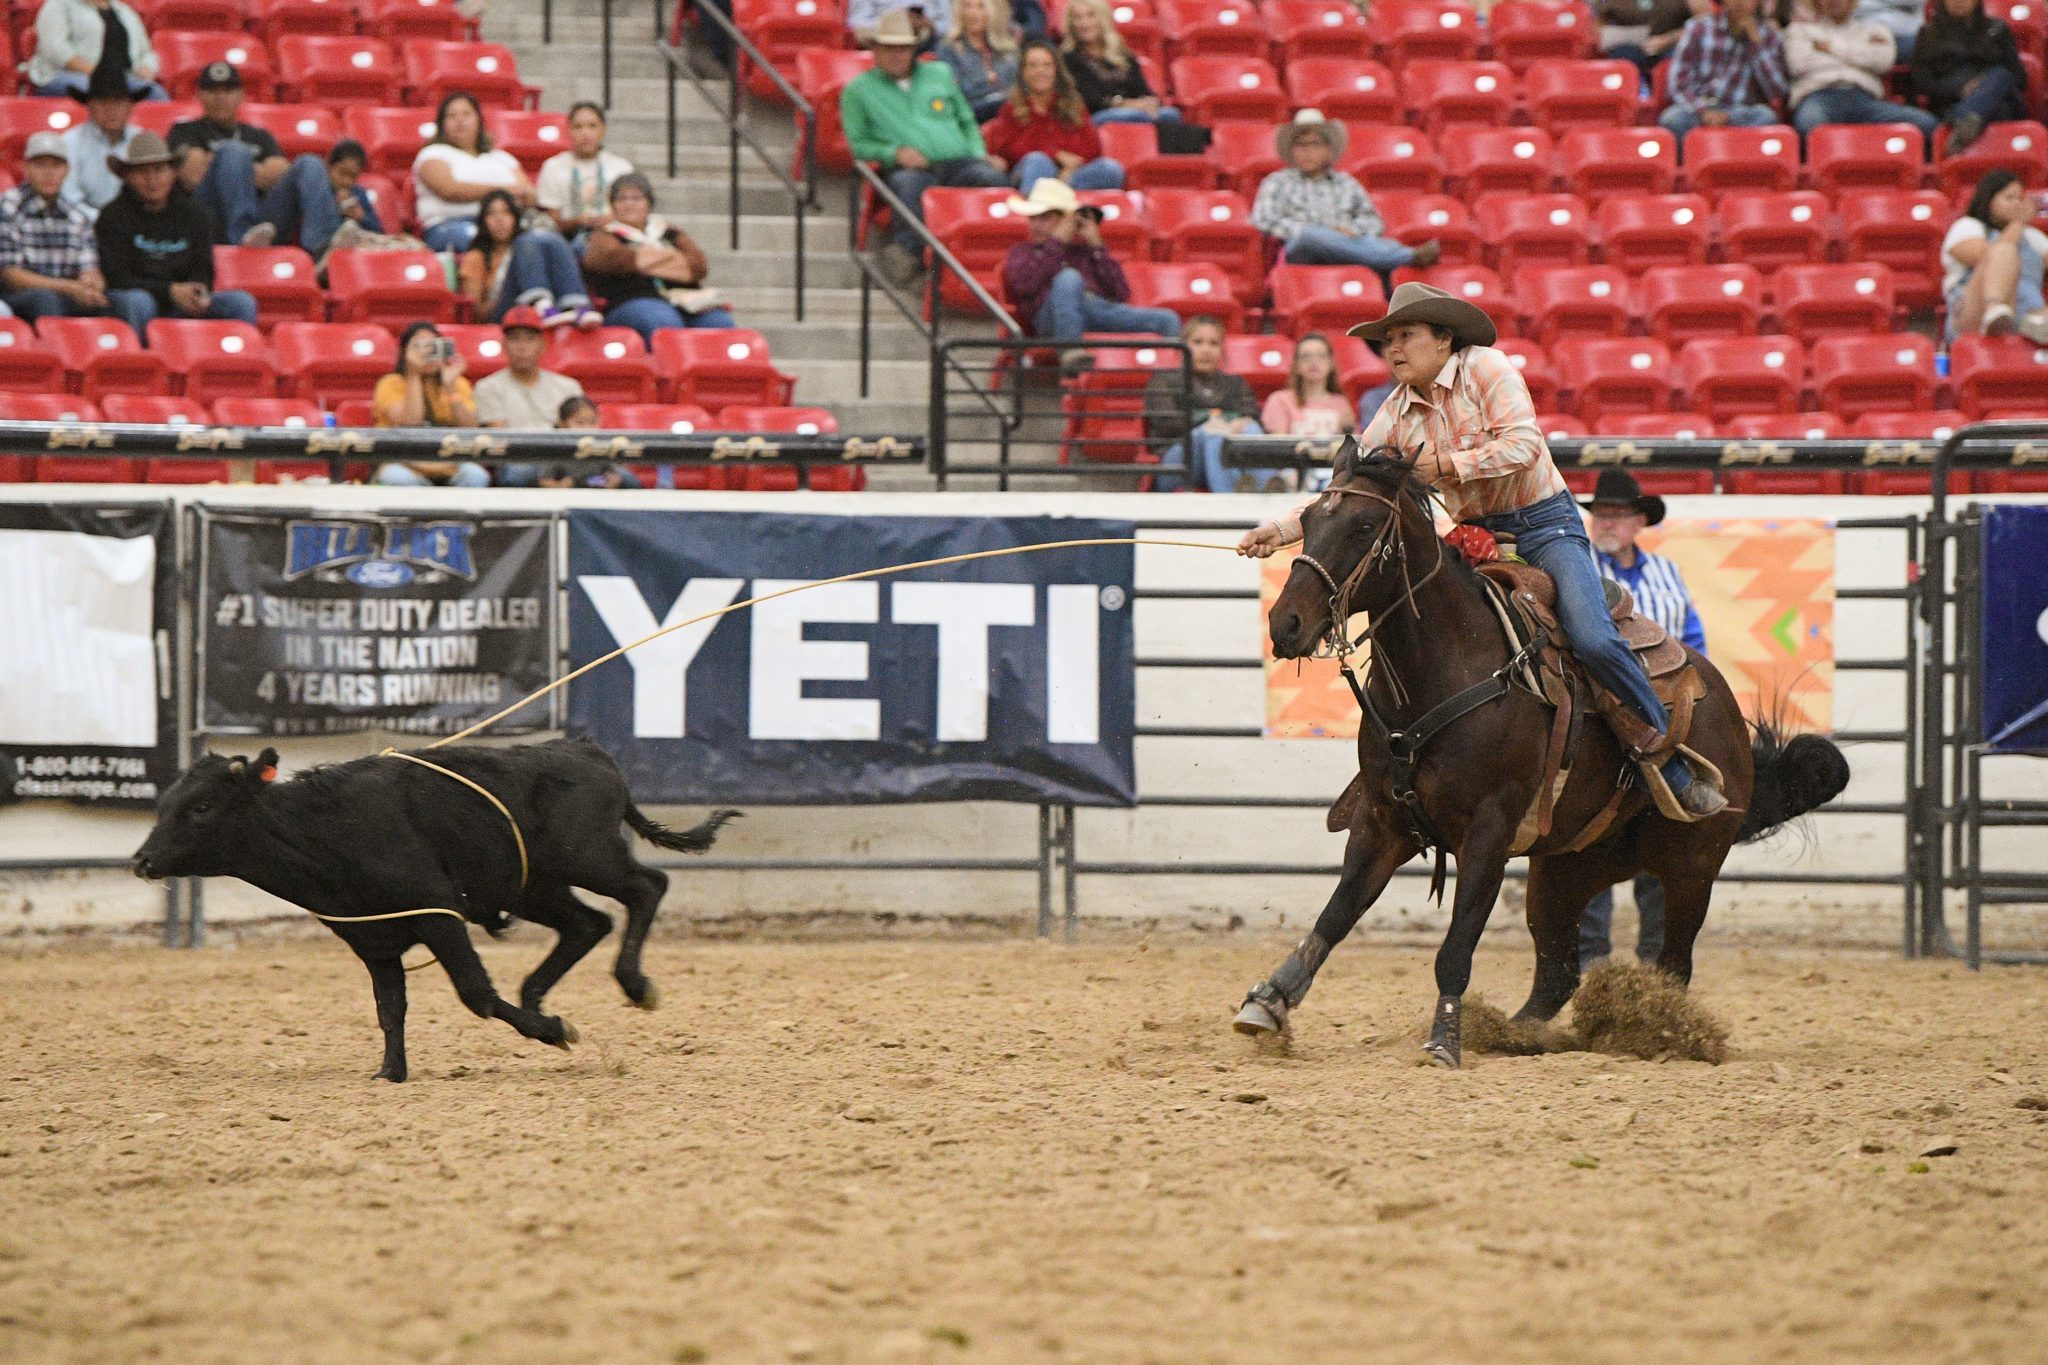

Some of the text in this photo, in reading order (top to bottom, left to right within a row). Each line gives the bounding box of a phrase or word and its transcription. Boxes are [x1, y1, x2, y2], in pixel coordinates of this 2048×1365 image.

[216, 595, 542, 632] #1 SUPER DUTY DEALER
[285, 633, 479, 669] IN THE NATION
[577, 575, 1099, 744] YETI
[256, 671, 501, 706] 4 YEARS RUNNING
